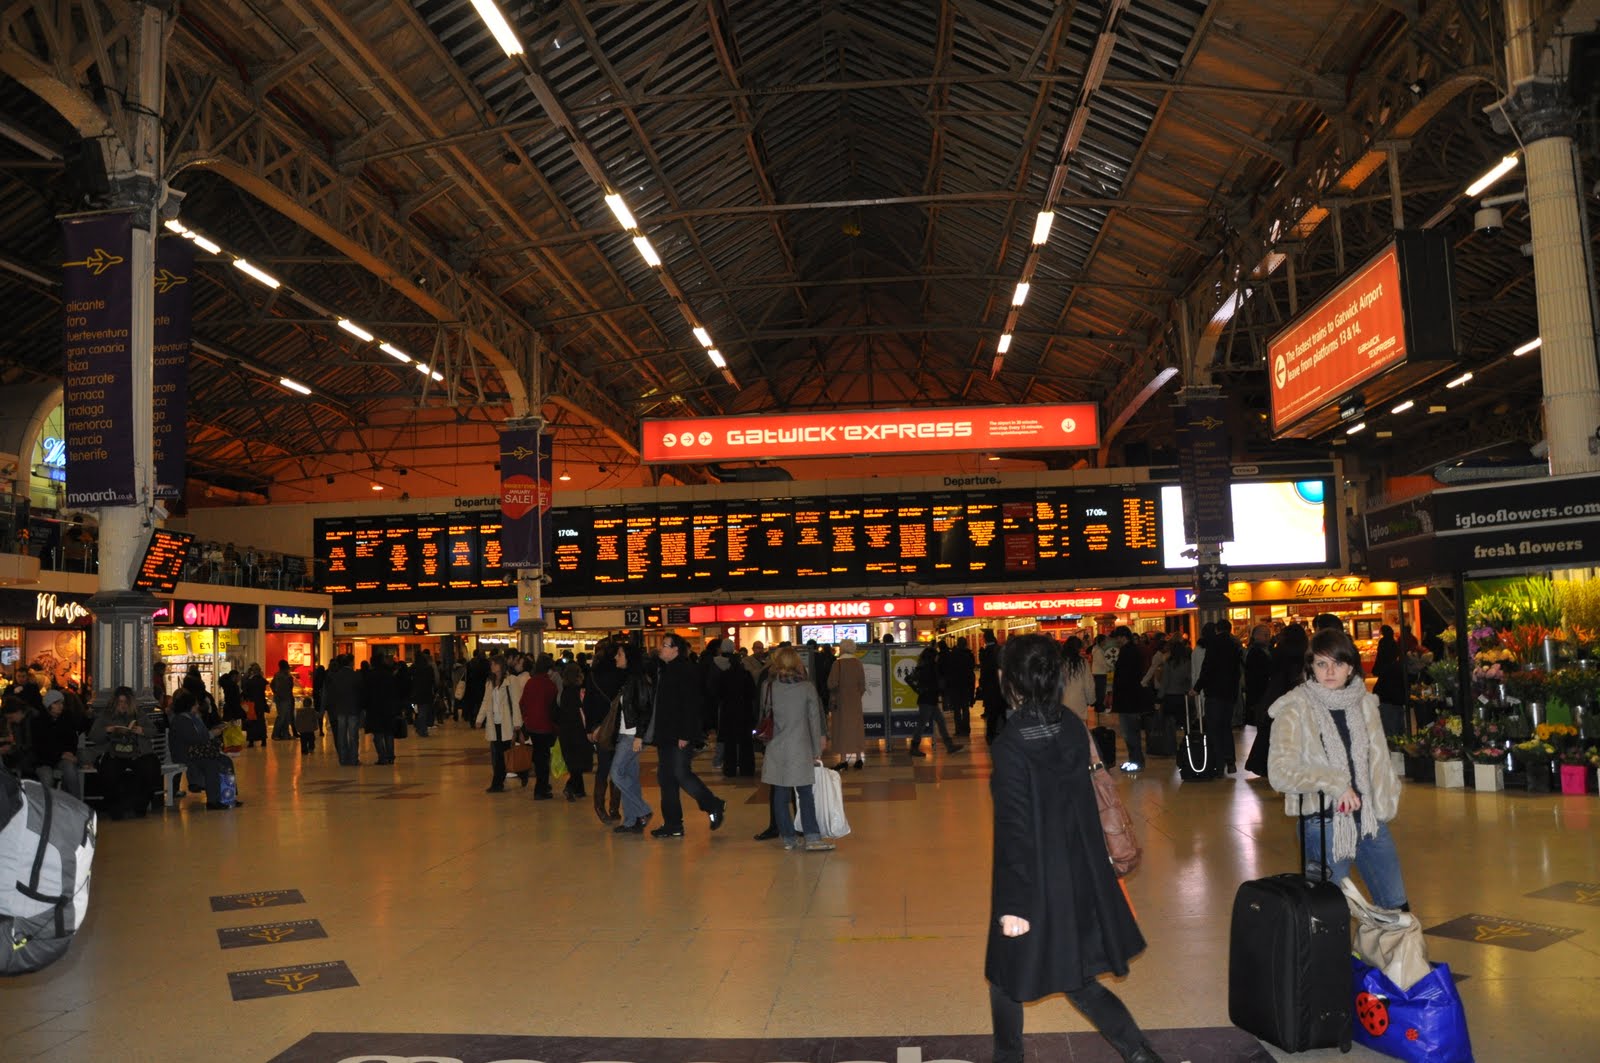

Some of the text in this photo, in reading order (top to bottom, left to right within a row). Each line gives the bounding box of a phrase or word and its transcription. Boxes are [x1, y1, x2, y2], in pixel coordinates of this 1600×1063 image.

[66, 300, 105, 312] alicante
[66, 316, 87, 327] faro
[1286, 283, 1383, 362] The fastest trains to Gatwick Airport
[66, 328, 128, 342] fuerteventura
[67, 342, 125, 358] gran canaria
[1287, 366, 1300, 381] leave
[1300, 357, 1313, 372] from
[1313, 340, 1339, 368] platforms
[1339, 331, 1346, 346] 13
[67, 360, 89, 372] ibiza
[68, 373, 115, 386] lanzarote
[68, 389, 104, 401] larnaca
[68, 404, 104, 417] malaga
[68, 418, 113, 430] menorca
[69, 433, 102, 445] murcia
[69, 448, 108, 461] tenerife
[505, 494, 533, 504] SALE!
[1456, 502, 1600, 529] iglooflowers.com
[1474, 540, 1583, 559] fresh flowers
[1296, 579, 1365, 596] Upper Crust
[1132, 596, 1158, 605] Tickets
[764, 602, 871, 619] BURGER KING
[952, 602, 964, 613] 13
[198, 604, 230, 626] HMV
[293, 614, 300, 624] de
[626, 612, 638, 622] 12
[398, 619, 409, 629] 10
[459, 619, 468, 628] 11
